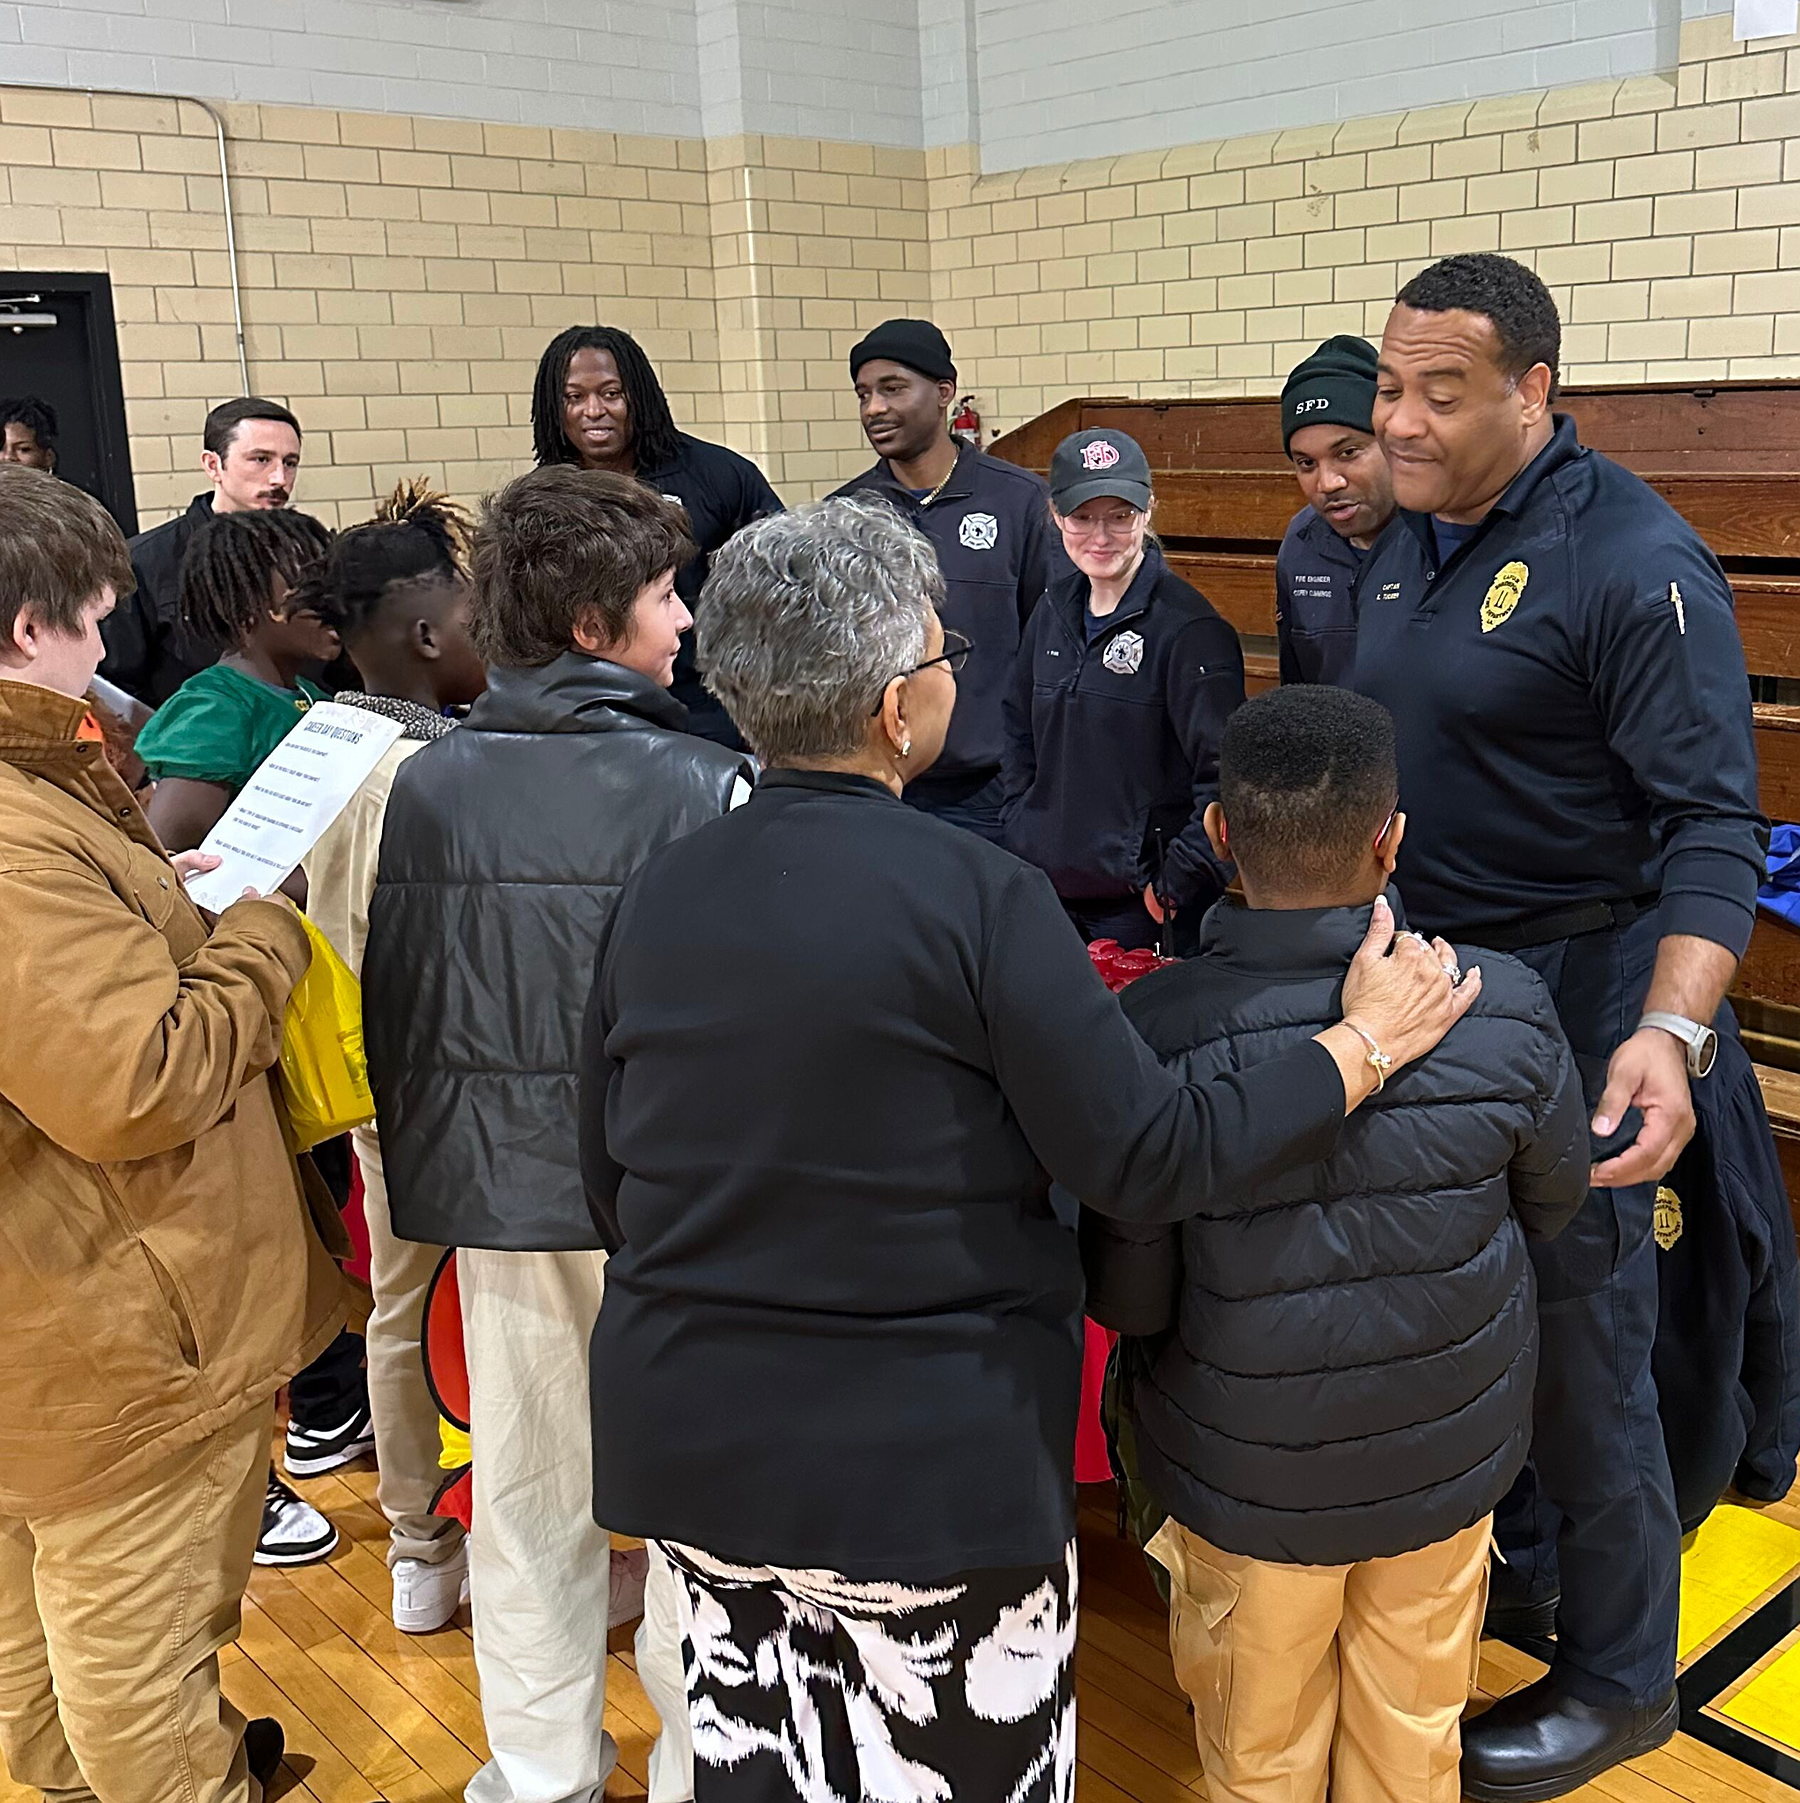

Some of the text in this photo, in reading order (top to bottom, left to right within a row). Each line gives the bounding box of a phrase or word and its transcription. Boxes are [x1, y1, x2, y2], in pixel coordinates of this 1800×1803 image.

[1296, 398, 1329, 415] SFD
[1295, 575, 1306, 583] FIRE
[330, 726, 363, 744] QUESTIONS
